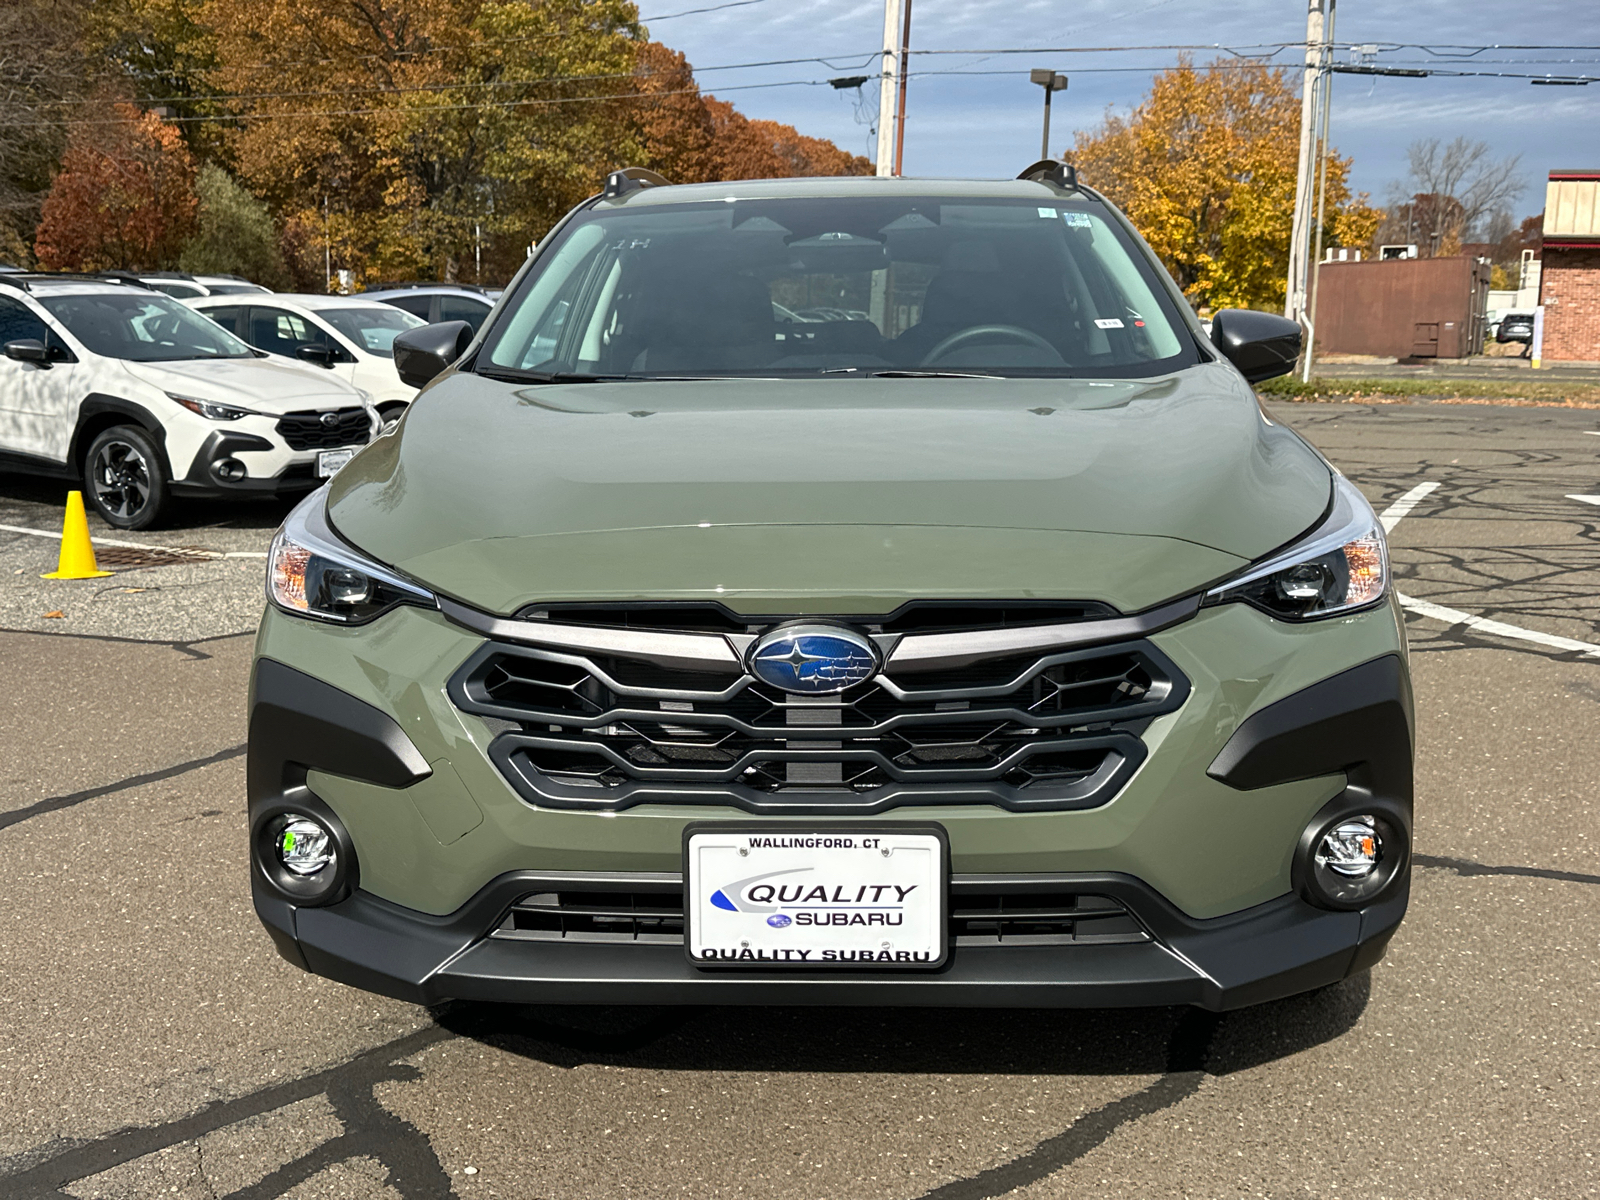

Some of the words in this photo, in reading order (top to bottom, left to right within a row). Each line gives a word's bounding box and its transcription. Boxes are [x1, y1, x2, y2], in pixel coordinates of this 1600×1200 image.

[749, 837, 858, 849] WALLINGFORD,
[862, 838, 881, 849] CT
[747, 884, 919, 904] QUALITY
[795, 912, 903, 926] SUBARU
[701, 948, 812, 961] QUALITY
[821, 949, 930, 963] SUBARU
